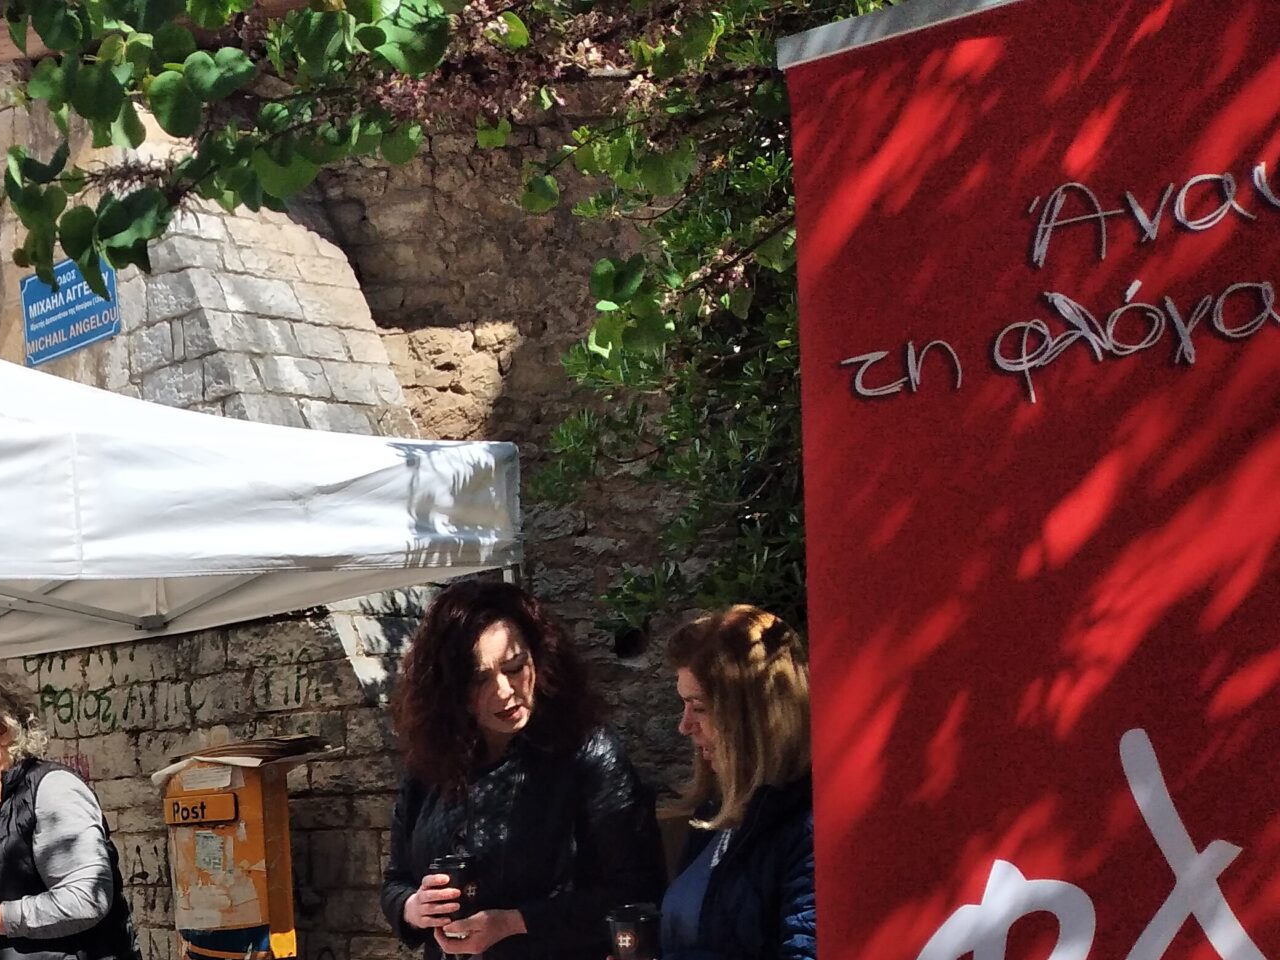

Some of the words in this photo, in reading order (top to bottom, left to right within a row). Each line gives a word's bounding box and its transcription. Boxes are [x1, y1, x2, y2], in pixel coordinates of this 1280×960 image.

[28, 291, 66, 320] ΜΙΧΑΗΛ
[65, 271, 110, 305] ΑΓΓΕΥ
[26, 328, 68, 354] MICHAIL
[69, 306, 117, 338] ANGELOU
[172, 801, 207, 821] Post
